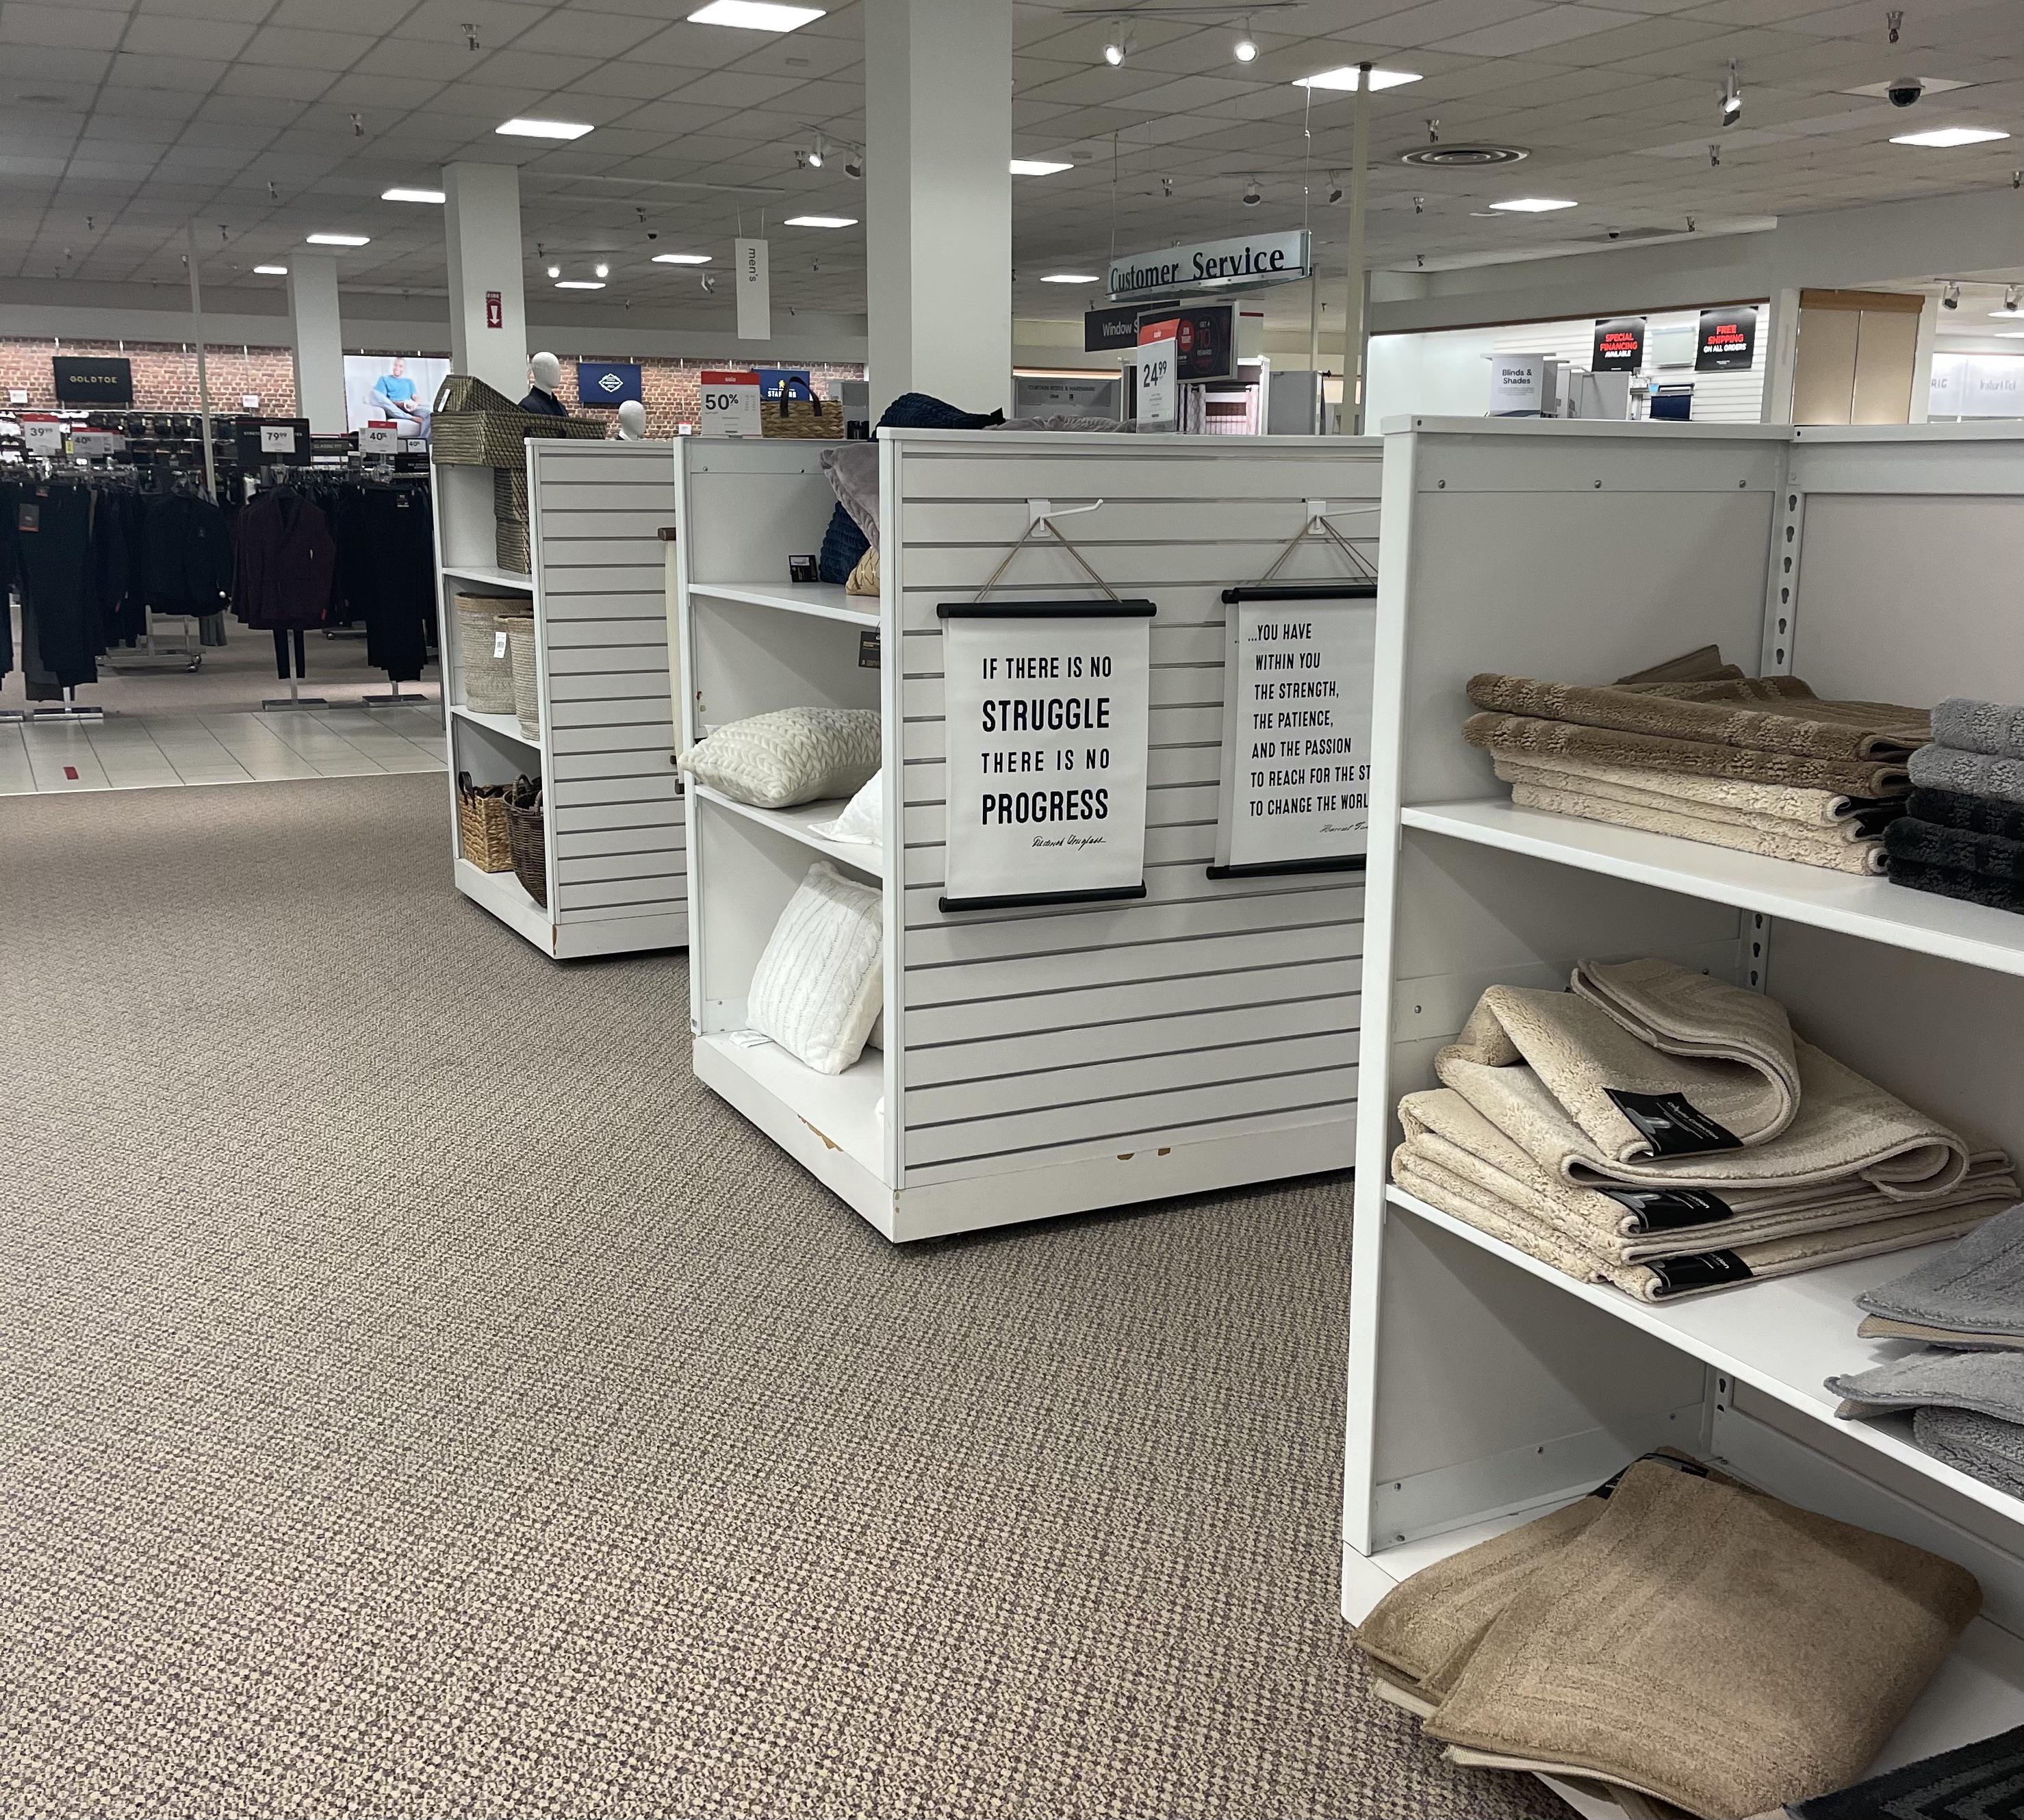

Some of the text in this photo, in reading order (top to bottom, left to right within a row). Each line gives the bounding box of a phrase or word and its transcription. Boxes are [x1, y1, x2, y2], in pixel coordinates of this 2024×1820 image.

[748, 248, 758, 282] men's
[1110, 247, 1284, 292] Customer Service
[1103, 318, 1138, 337] Window S
[1605, 333, 1634, 342] SPECIAL
[1717, 324, 1737, 335] FREE
[1600, 342, 1638, 351] FINANCING
[1708, 334, 1744, 345] SHIPPING
[1724, 343, 1747, 352] ORDERS
[1931, 379, 1947, 388] RIG
[705, 394, 739, 411] 50%
[1283, 623, 1312, 640] HAVE
[983, 656, 1112, 680] IF THERE IS NO
[1255, 652, 1320, 671] WITHIN YOU
[1254, 680, 1340, 700] THE STRENGTH,
[982, 697, 1110, 732] STRUGGLE
[1253, 710, 1333, 730] THE PATIENCE,
[1251, 737, 1351, 759] AND THE PASSION
[982, 748, 1110, 774] THERE IS NO
[1251, 765, 1371, 788] TO REACH FOR THE ST
[982, 789, 1108, 825] PROGRESS
[1249, 793, 1368, 817] TO CHANGE THE WORL
